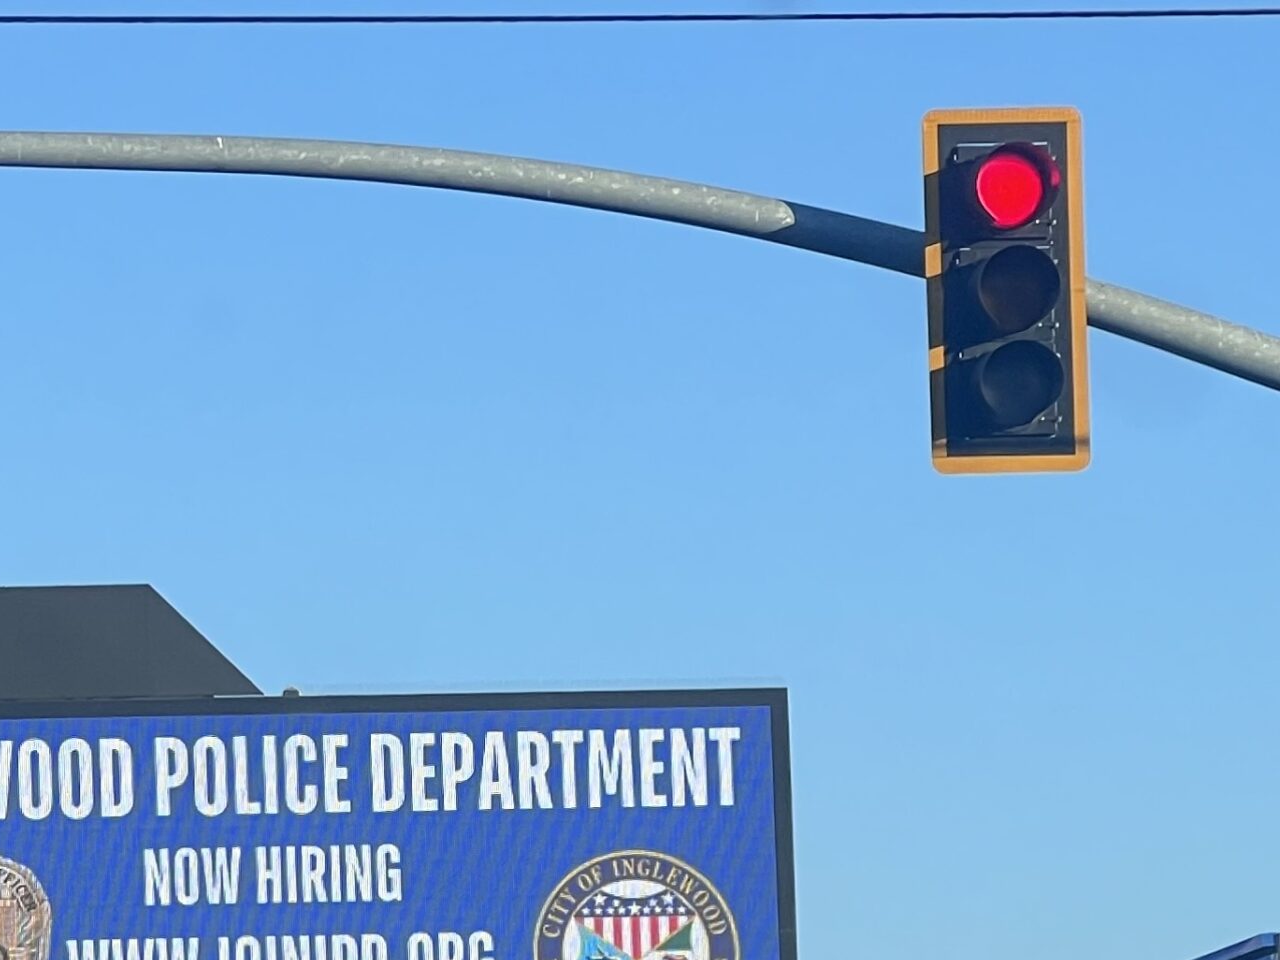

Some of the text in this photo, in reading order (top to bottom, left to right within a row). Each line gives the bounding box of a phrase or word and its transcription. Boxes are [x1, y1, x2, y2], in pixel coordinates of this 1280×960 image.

[155, 734, 351, 817] POLICE
[371, 727, 741, 812] DEPARTMENT
[144, 844, 402, 906] NOW HIRING
[542, 858, 727, 938] CITY OF INGLEWOOD
